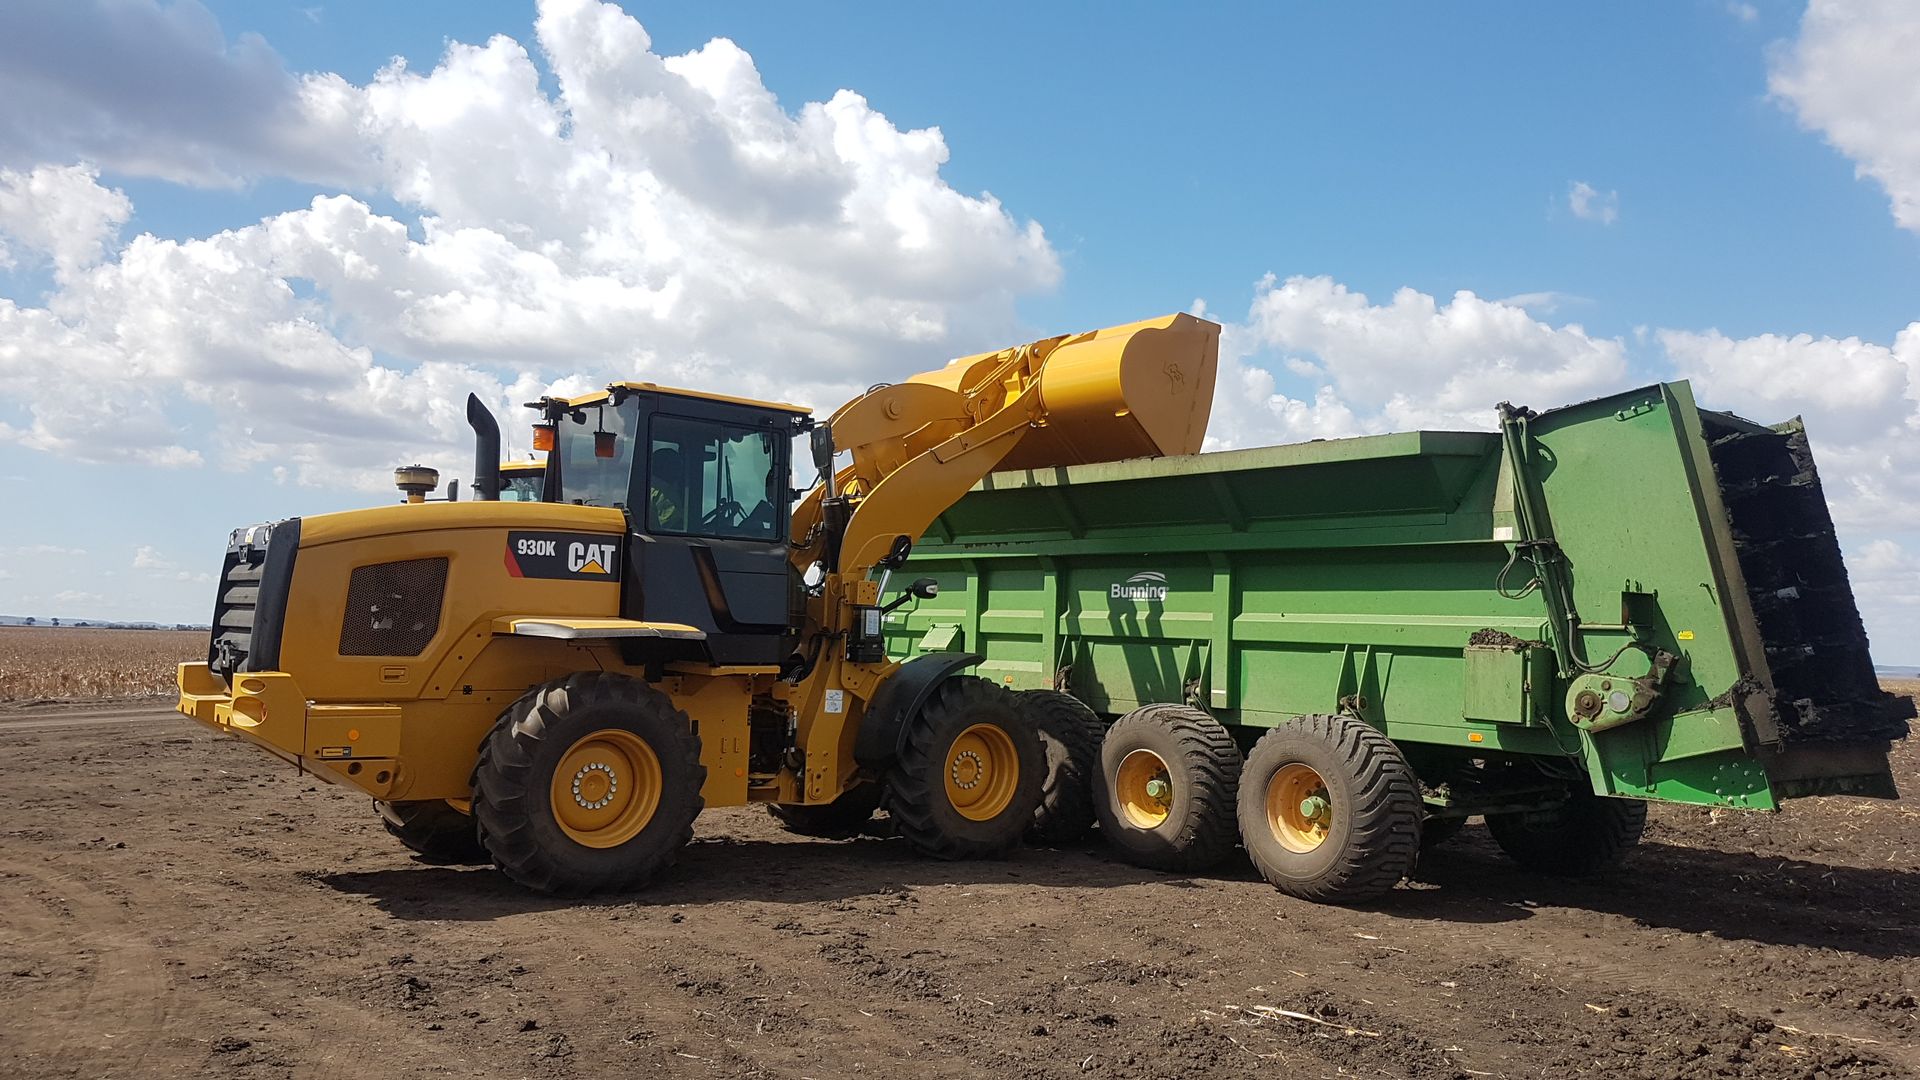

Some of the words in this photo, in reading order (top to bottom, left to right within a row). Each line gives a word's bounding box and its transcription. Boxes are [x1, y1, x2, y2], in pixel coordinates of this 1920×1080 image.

[517, 539, 556, 557] 930K
[567, 541, 616, 575] CAT
[1111, 583, 1166, 602] Bunning
